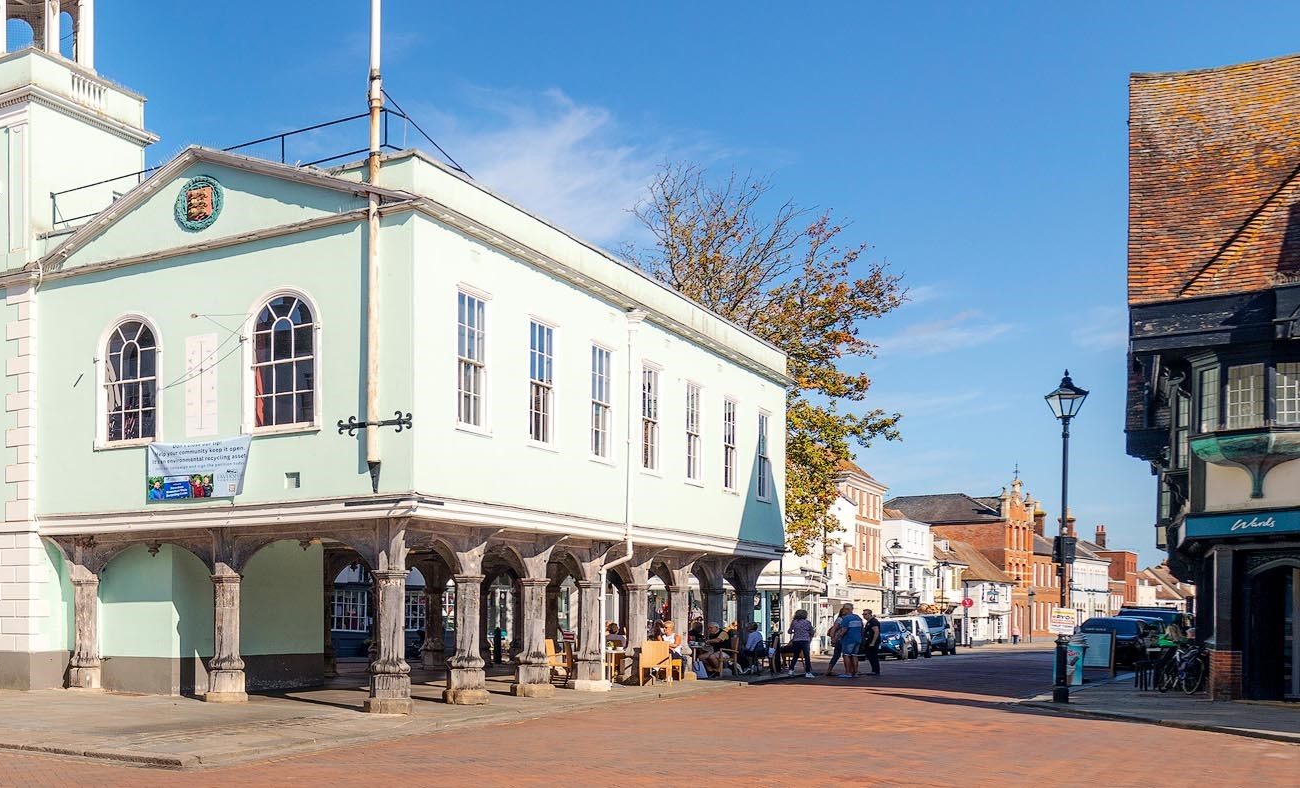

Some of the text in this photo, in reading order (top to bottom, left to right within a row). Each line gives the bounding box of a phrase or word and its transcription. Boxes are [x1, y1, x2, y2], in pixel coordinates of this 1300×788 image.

[178, 447, 209, 456] community
[209, 446, 222, 454] keep
[205, 454, 231, 462] recycling
[1230, 517, 1276, 531] Wards
